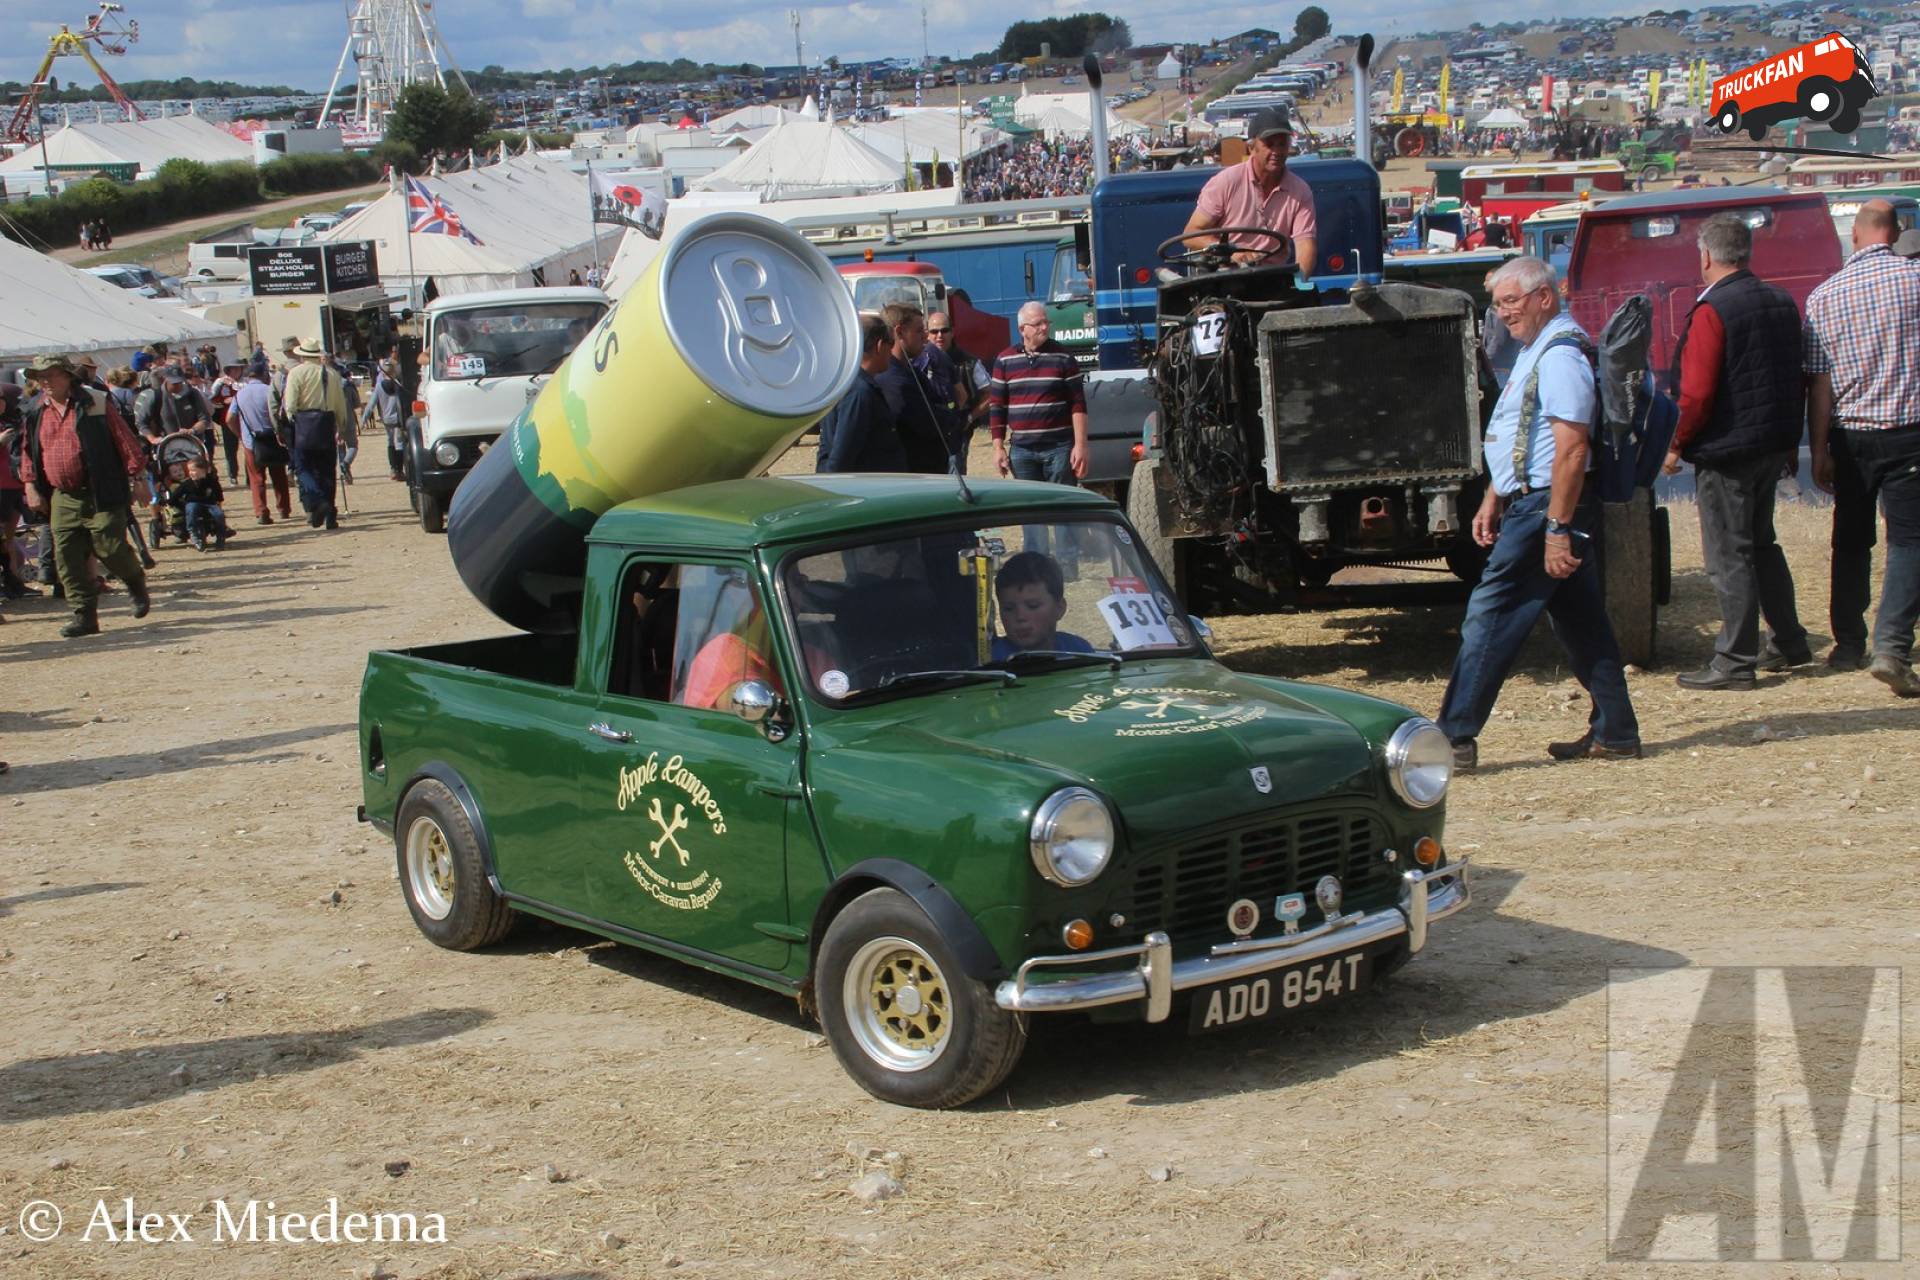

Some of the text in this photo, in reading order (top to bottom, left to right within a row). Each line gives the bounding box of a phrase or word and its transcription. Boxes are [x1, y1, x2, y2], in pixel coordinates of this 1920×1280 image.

[334, 251, 367, 265] BURGER
[336, 263, 369, 278] KITCHEN
[1055, 328, 1098, 341] MAIDM
[1200, 317, 1226, 340] 72
[461, 360, 483, 370] 145
[1108, 600, 1164, 629] 131
[618, 752, 728, 835] Apple Campers
[624, 851, 691, 909] Motor-Caravan
[689, 877, 722, 910] Repairs
[1203, 953, 1364, 1028] ADO 854T
